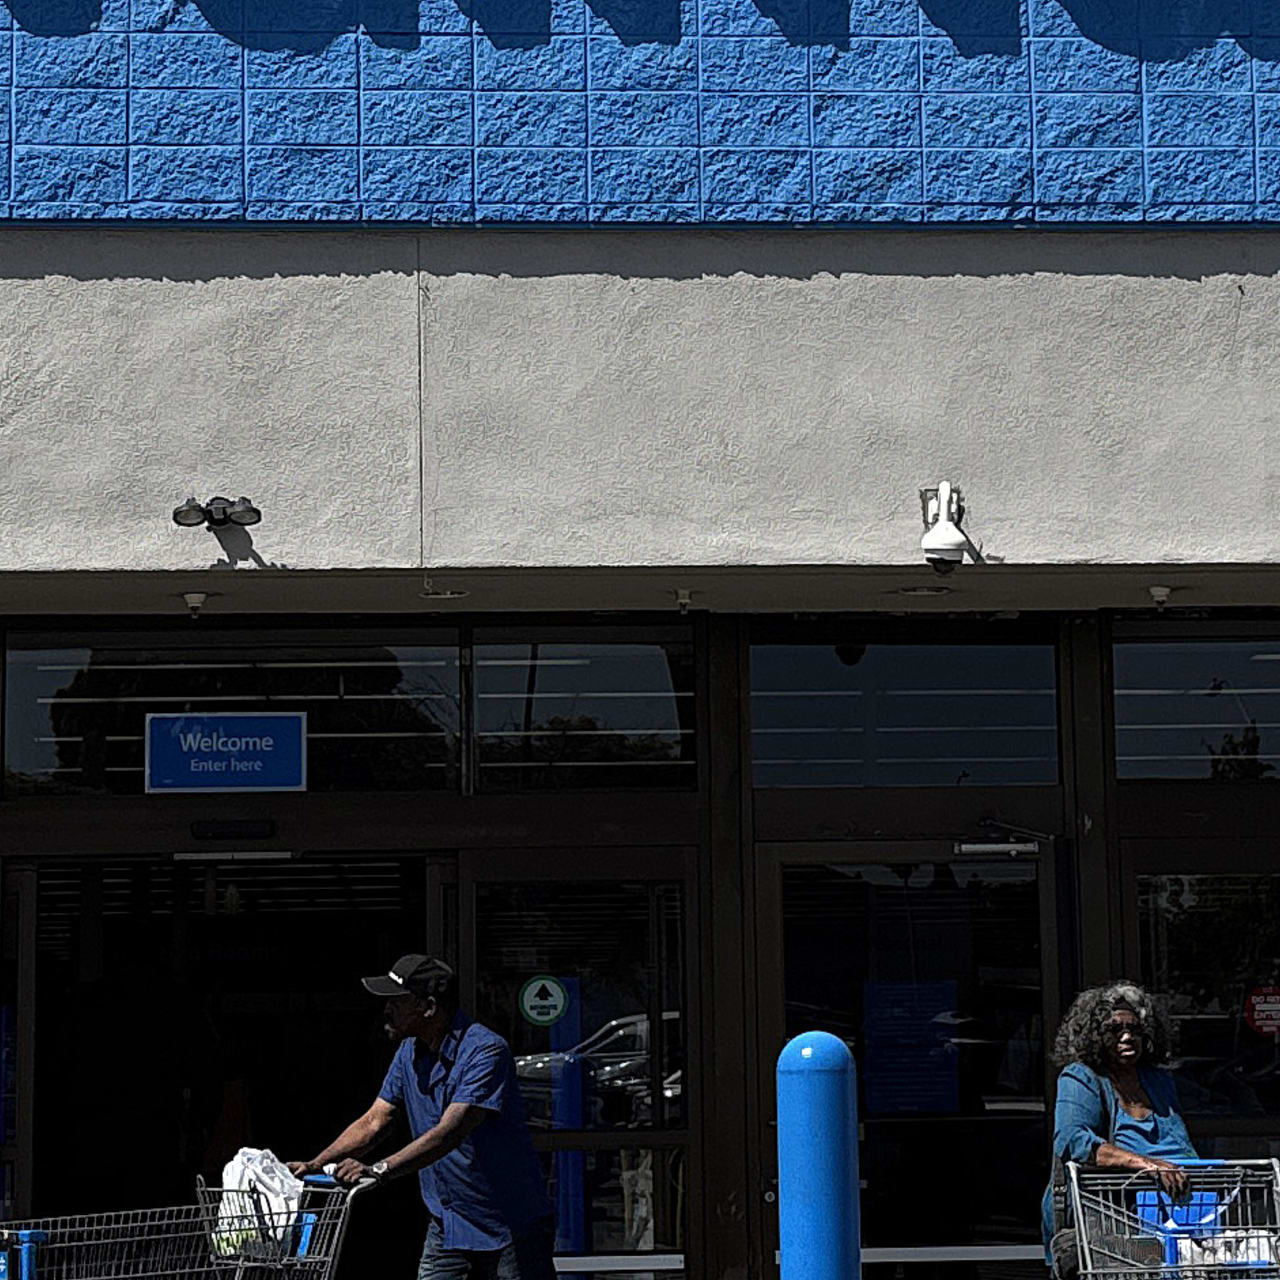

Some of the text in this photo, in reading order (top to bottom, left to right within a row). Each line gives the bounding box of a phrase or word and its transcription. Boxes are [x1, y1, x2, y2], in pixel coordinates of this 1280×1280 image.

[180, 732, 274, 752] Welcome
[190, 757, 263, 772] Enter here
